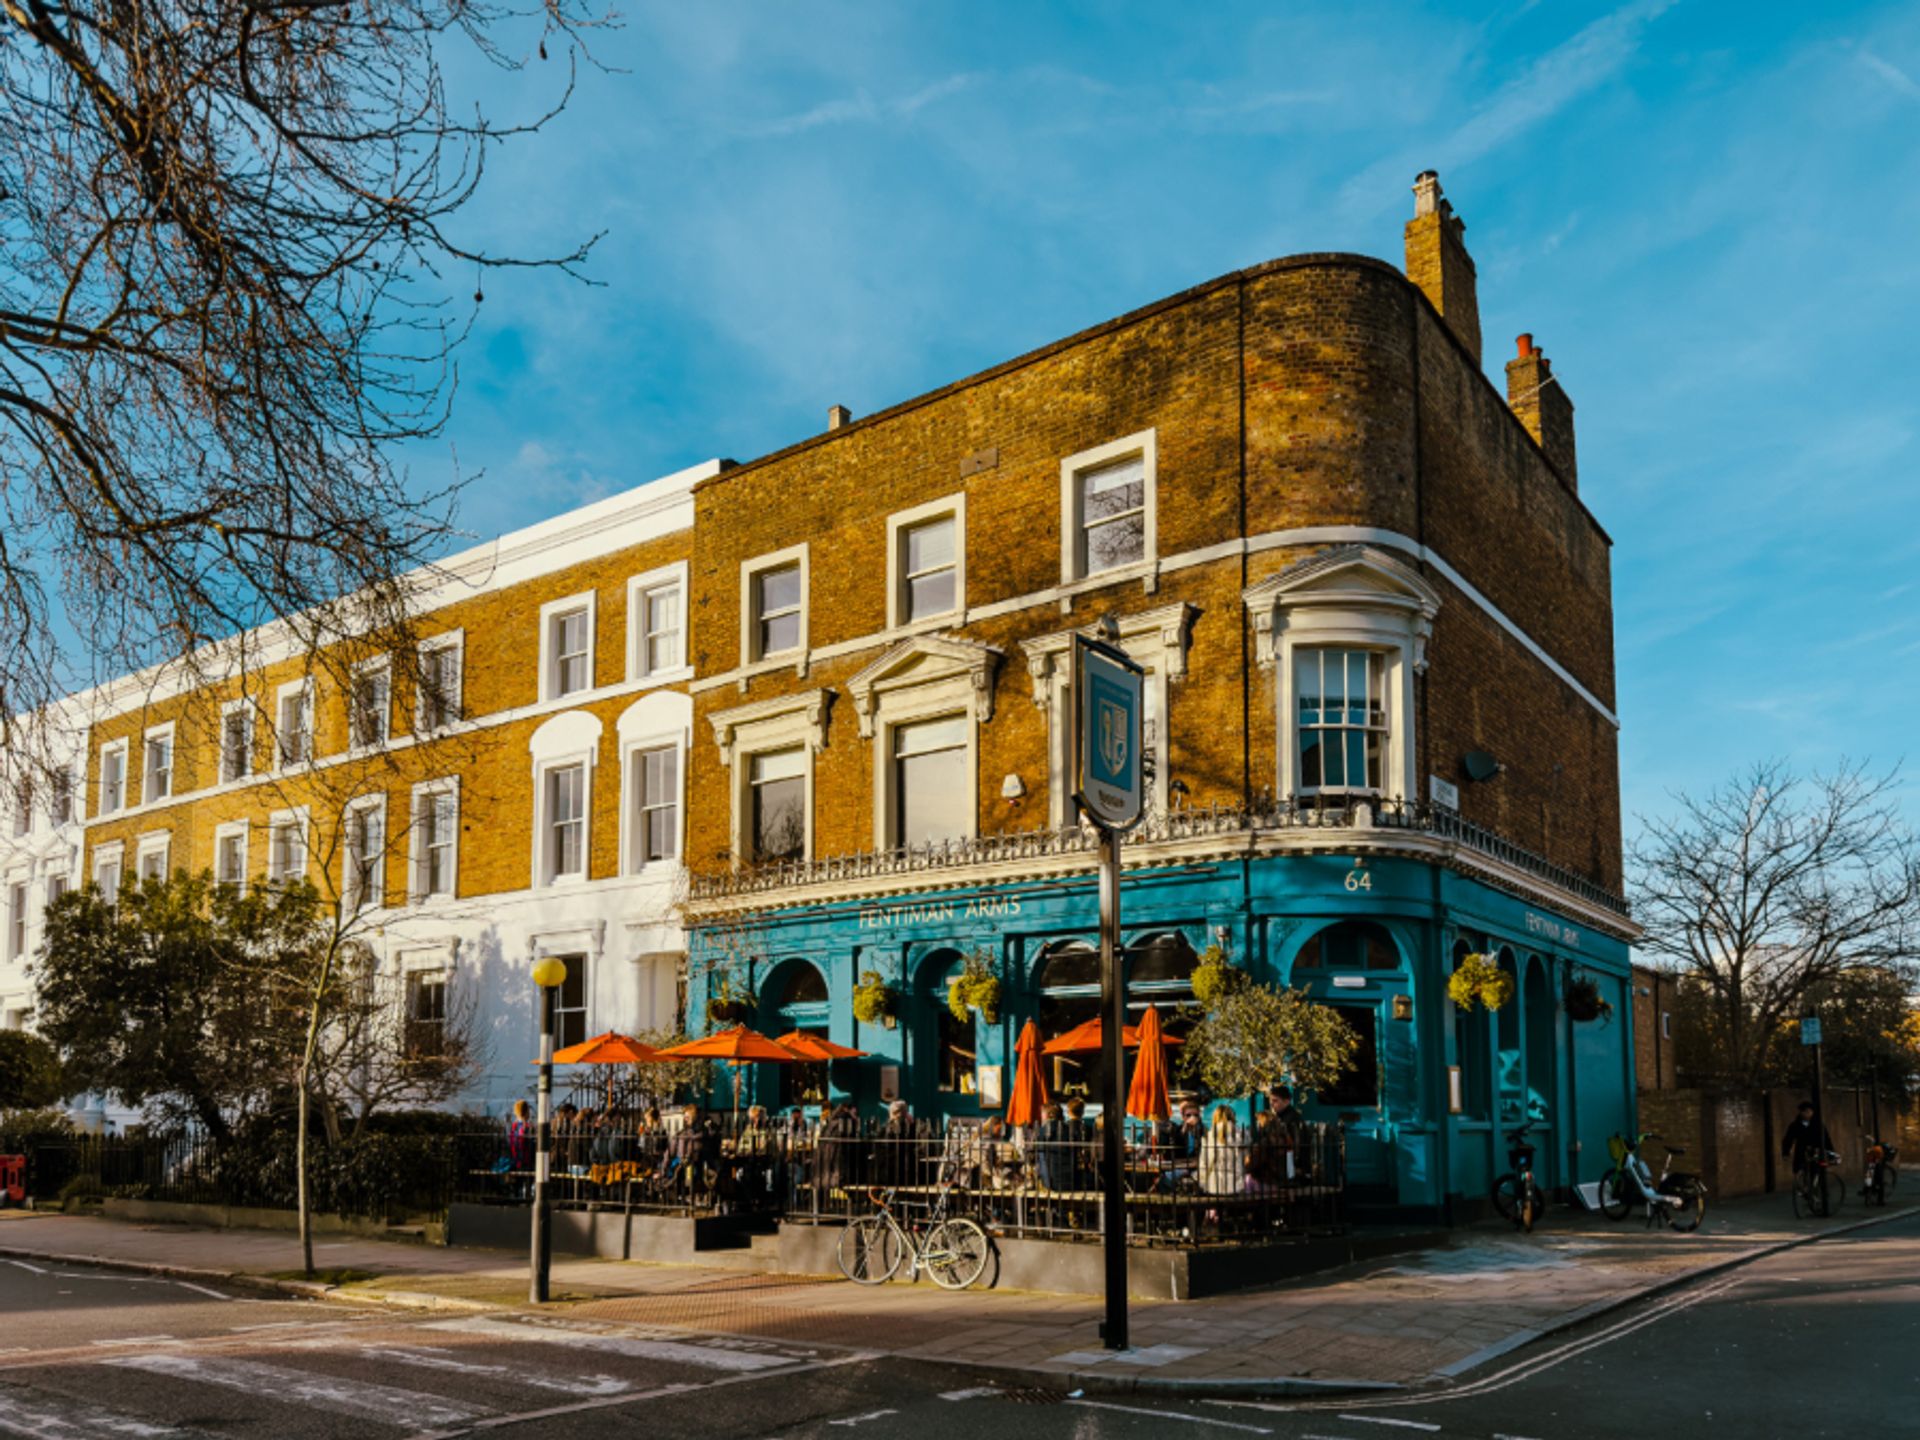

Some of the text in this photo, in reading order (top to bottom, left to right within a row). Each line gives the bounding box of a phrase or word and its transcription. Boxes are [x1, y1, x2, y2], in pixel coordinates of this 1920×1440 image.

[1344, 870, 1372, 891] 64
[859, 895, 1022, 929] FENTIMAN ARMS
